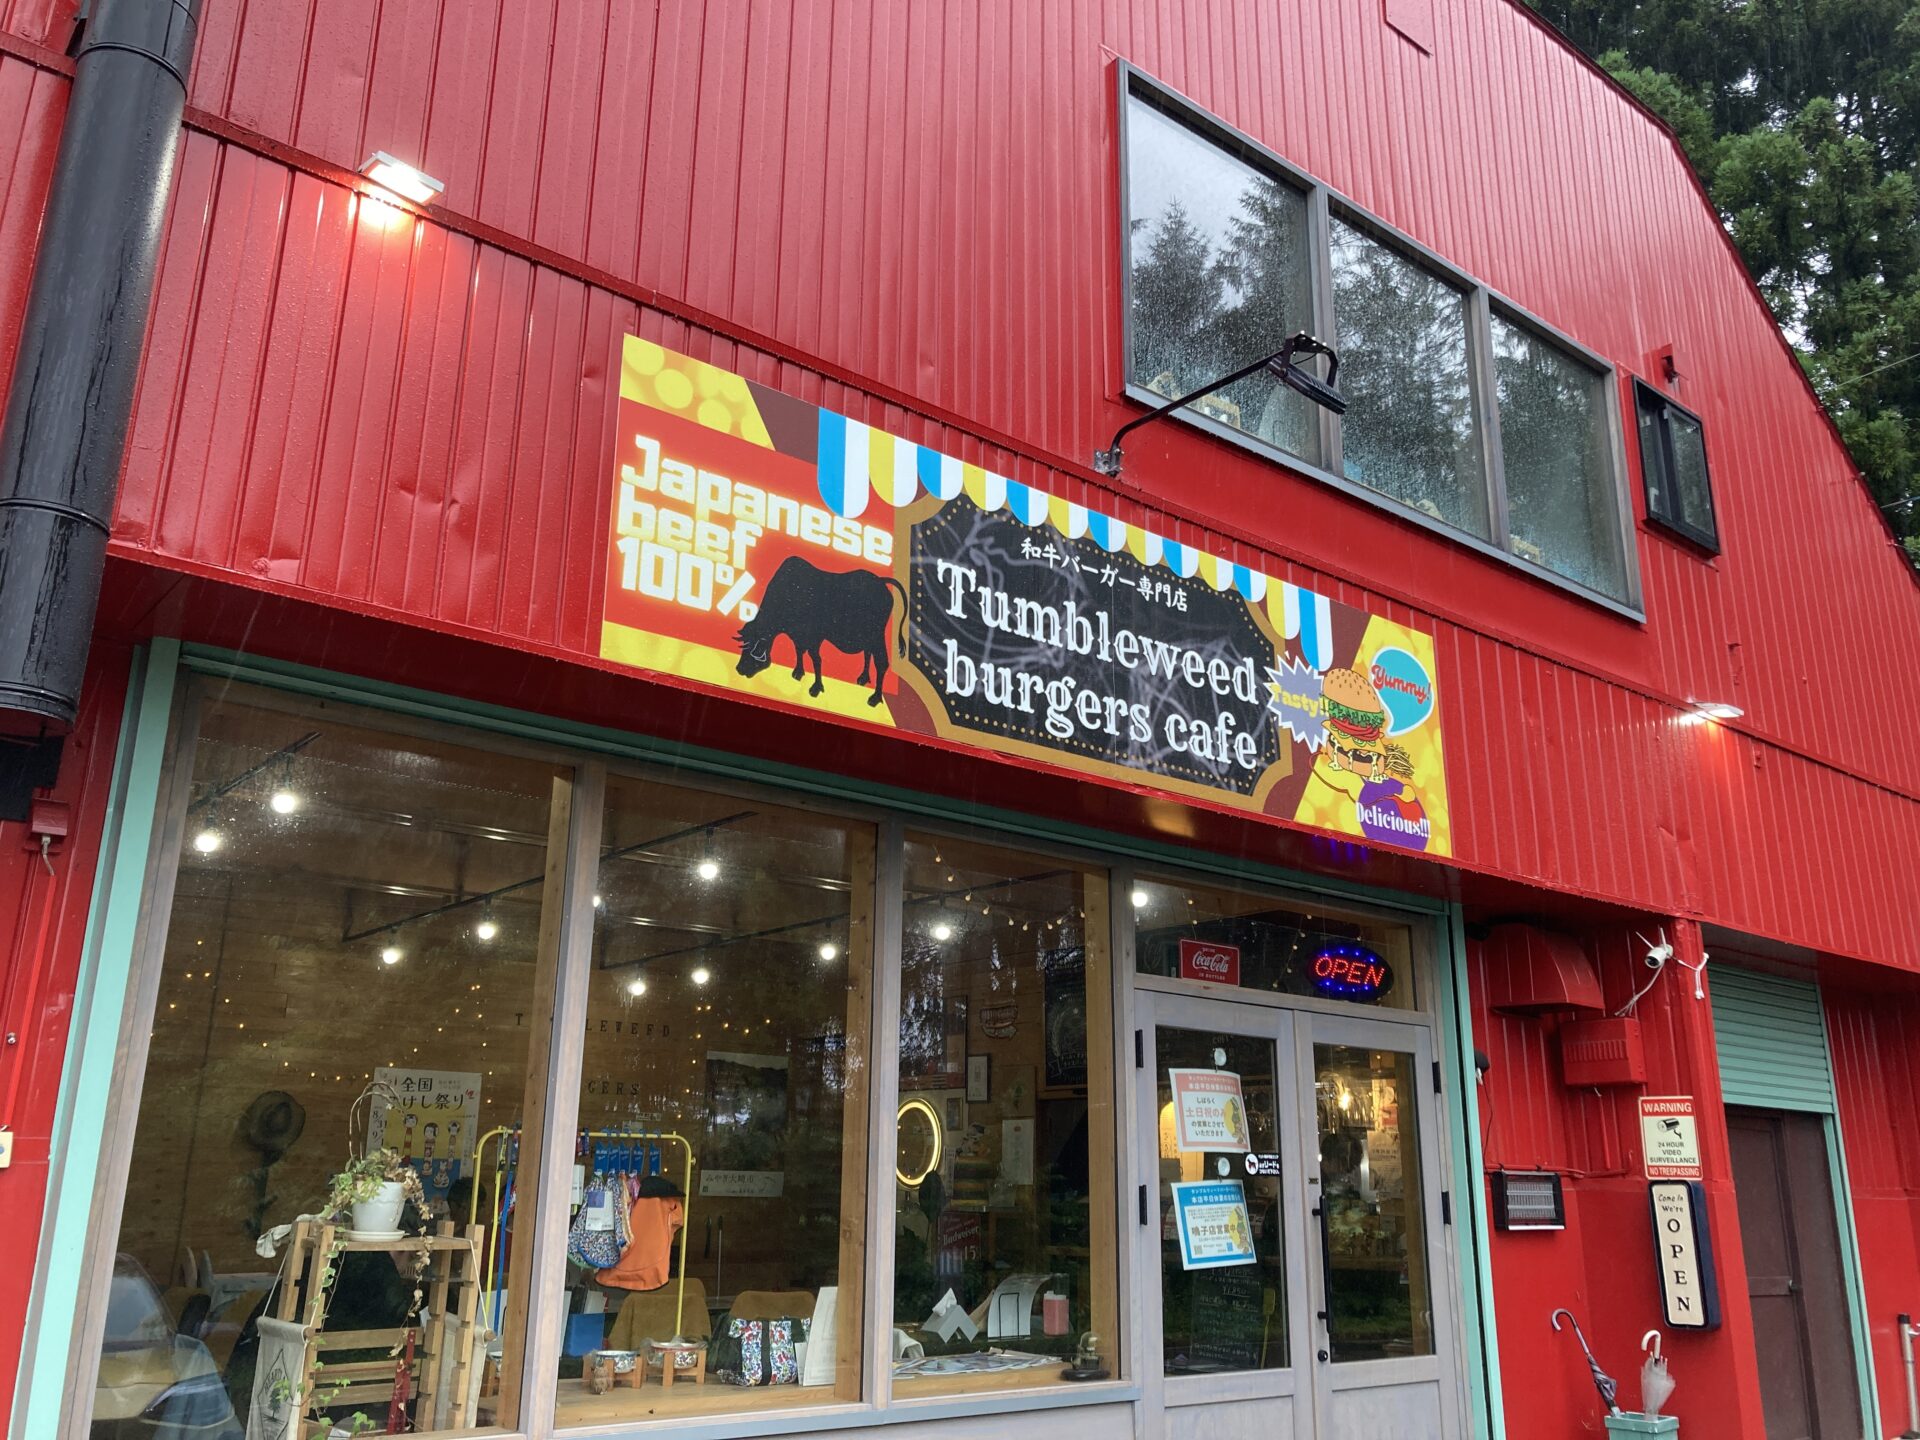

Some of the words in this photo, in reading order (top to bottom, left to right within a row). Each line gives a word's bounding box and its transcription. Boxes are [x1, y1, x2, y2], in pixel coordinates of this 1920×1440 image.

[621, 434, 894, 566] Japanese
[617, 482, 763, 570] beef
[616, 536, 759, 622] 100%
[1020, 537, 1189, 613] 和牛バーガー専門店
[937, 558, 1260, 707] Tumbleweed
[943, 638, 1152, 742] burgers
[1164, 710, 1258, 771] cafe
[1371, 663, 1432, 705] Yummy!
[1355, 801, 1432, 839] Delicious!!!
[1314, 956, 1386, 989] OPEN
[1643, 1102, 1692, 1113] WARNING
[1649, 1166, 1659, 1176] NO
[1659, 1166, 1700, 1176] TRESPASSING
[1650, 1156, 1697, 1164] SURVEILLANCE
[1658, 1193, 1676, 1202] Come
[1661, 1205, 1684, 1213] We're
[1667, 1218, 1691, 1312] OPEN
